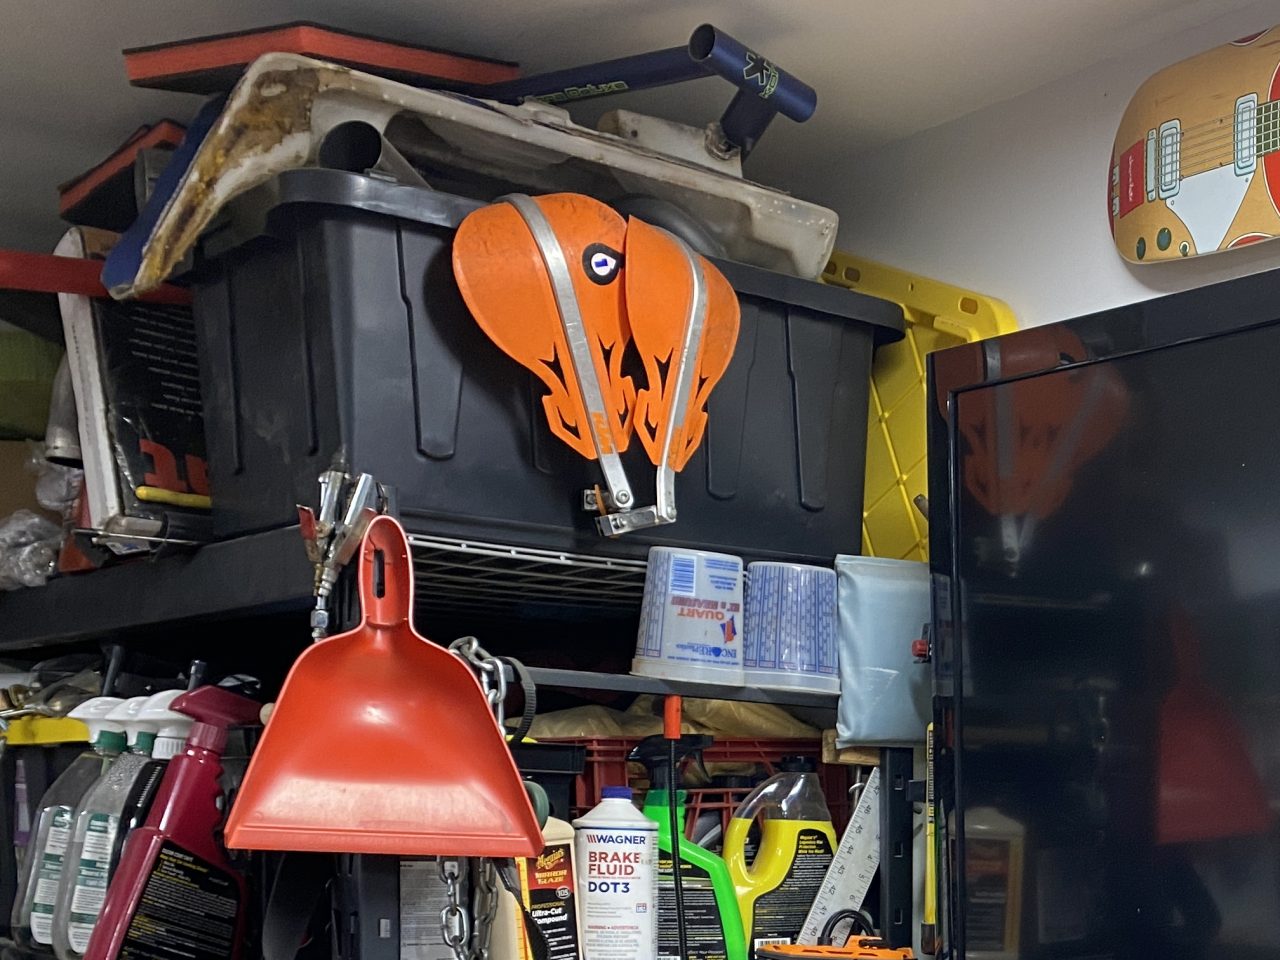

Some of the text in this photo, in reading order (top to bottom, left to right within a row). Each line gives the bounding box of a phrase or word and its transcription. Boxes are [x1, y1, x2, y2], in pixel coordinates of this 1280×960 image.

[677, 607, 725, 621] QUART
[596, 834, 646, 845] WAGNER
[589, 851, 642, 863] BRAKE
[589, 864, 634, 876] FLUID
[532, 907, 562, 917] Ultra-Cut
